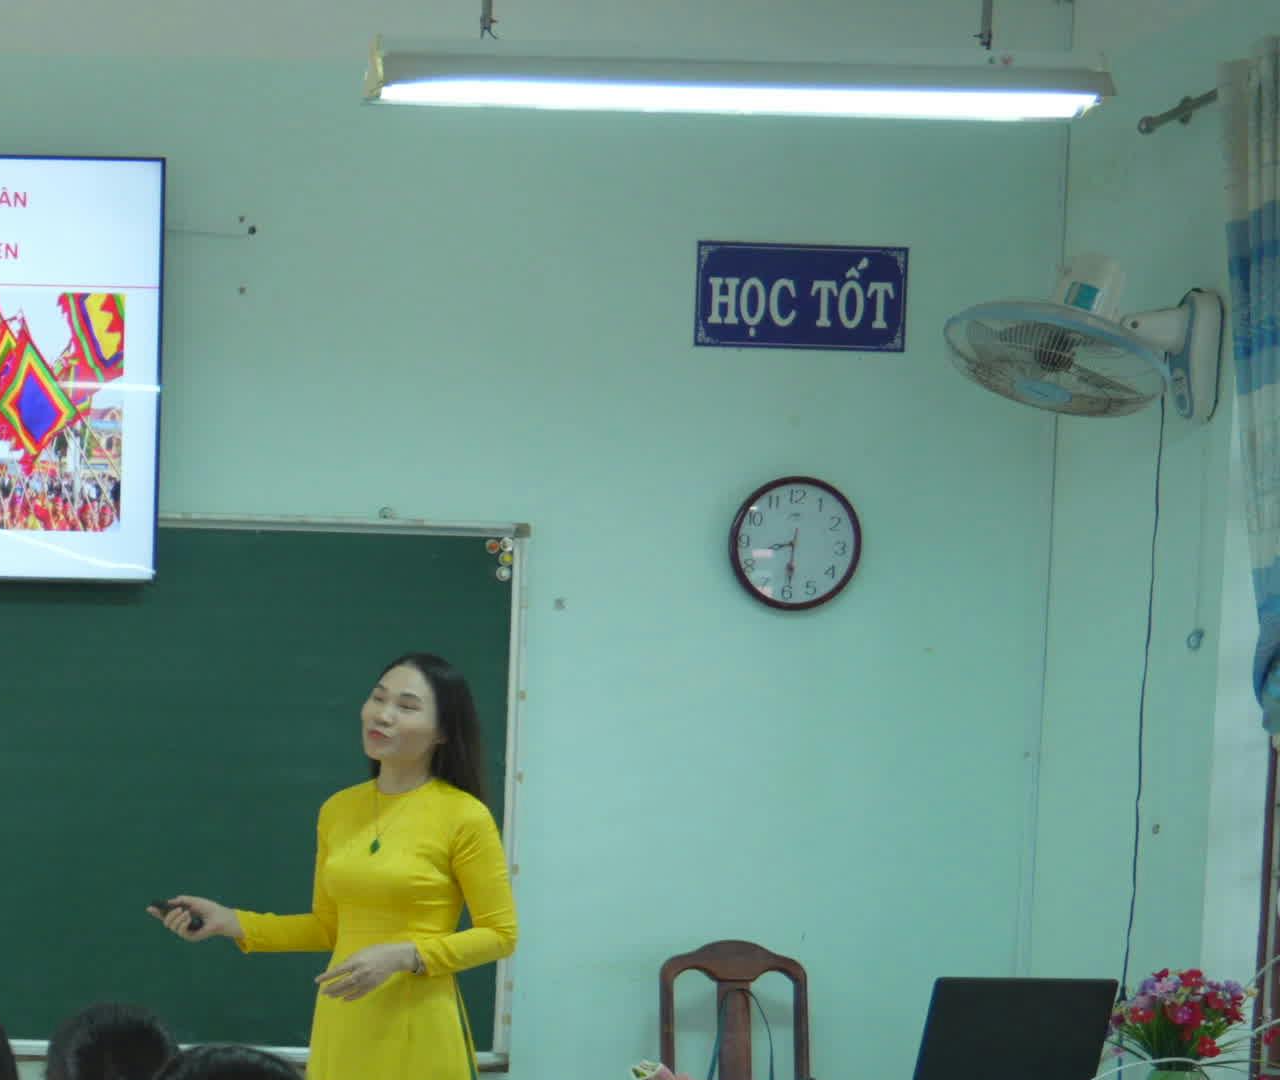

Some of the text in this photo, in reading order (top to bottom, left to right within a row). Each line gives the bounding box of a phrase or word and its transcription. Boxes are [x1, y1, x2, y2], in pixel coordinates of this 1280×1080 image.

[706, 256, 895, 337] HỌC TỐT
[768, 495, 780, 510] 11
[790, 488, 807, 504] 12
[748, 511, 763, 527] 10
[829, 516, 841, 532] 2
[740, 534, 750, 548] 9
[834, 541, 847, 557] 3
[824, 564, 836, 579] 4
[781, 585, 792, 600] 6
[805, 580, 817, 595] 5
